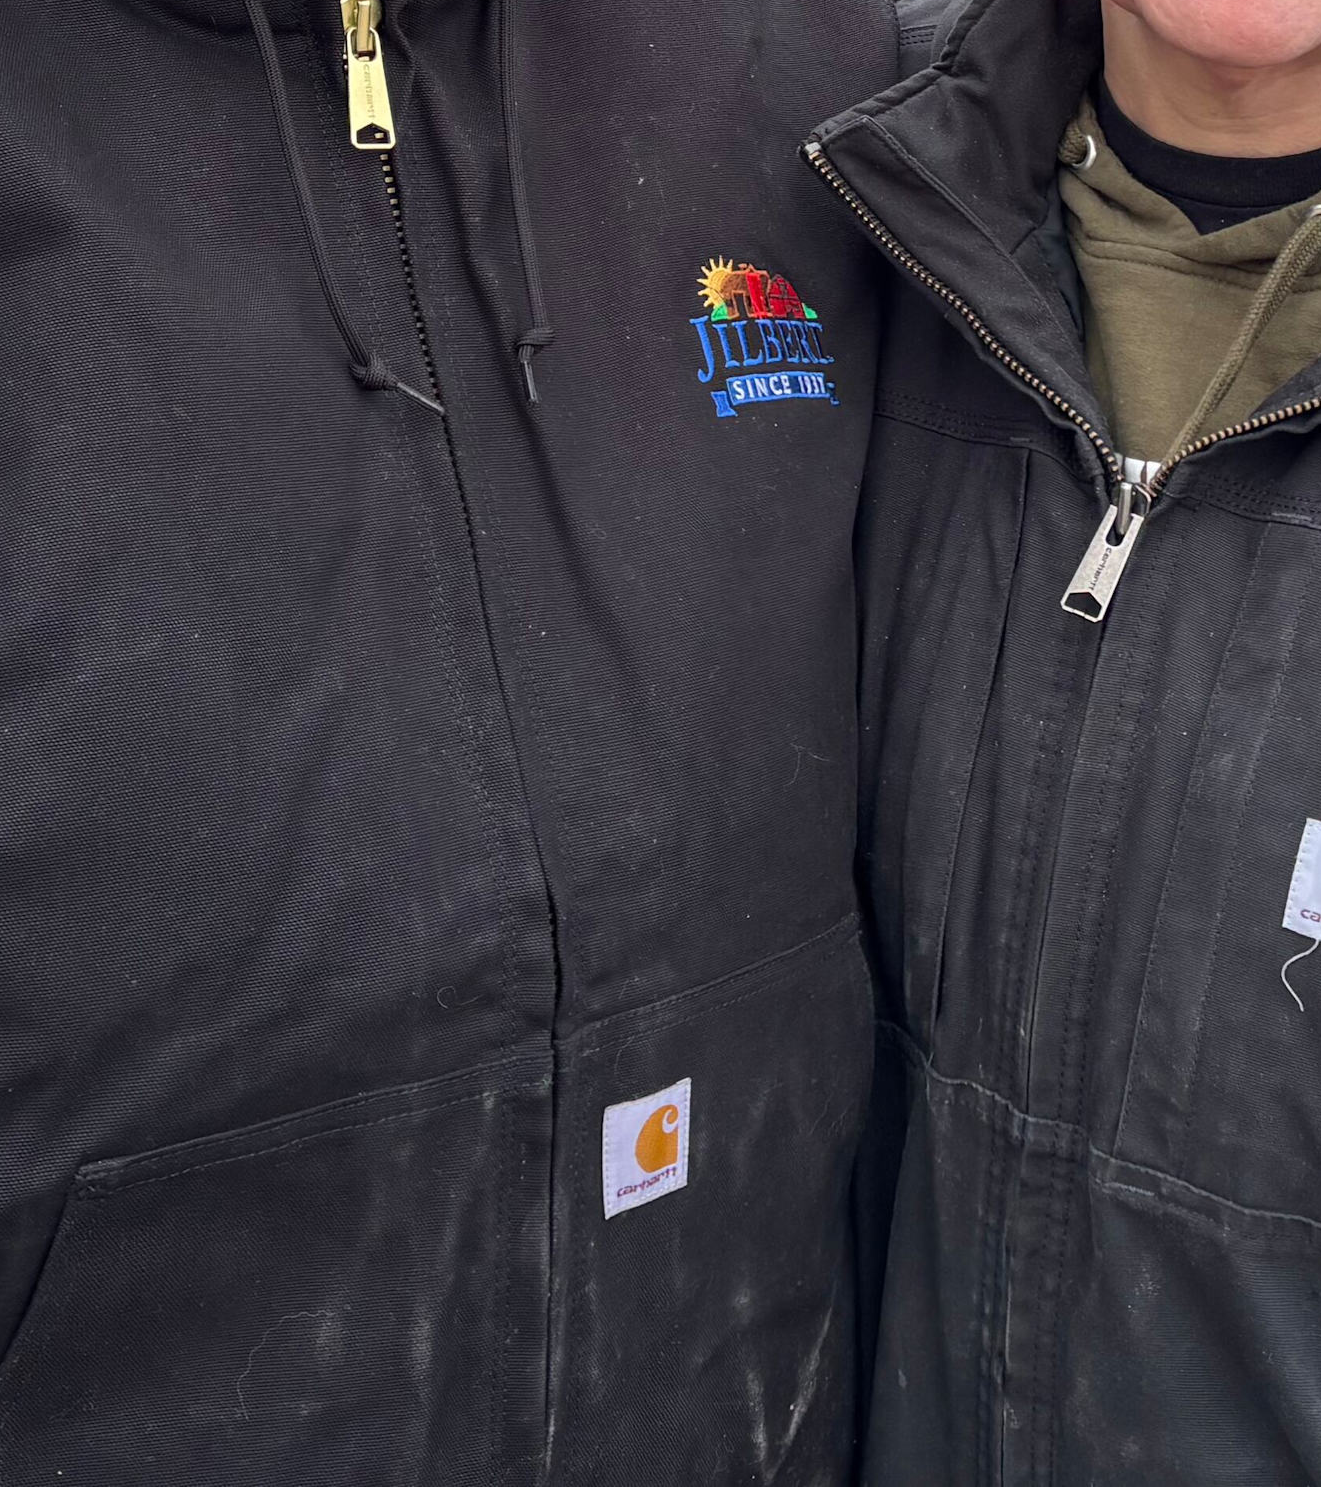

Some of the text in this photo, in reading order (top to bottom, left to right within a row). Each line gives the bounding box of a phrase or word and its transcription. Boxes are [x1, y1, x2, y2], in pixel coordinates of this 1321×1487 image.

[689, 315, 832, 384] JILBERT
[731, 374, 793, 400] SINCE
[616, 1166, 678, 1198] carhartt
